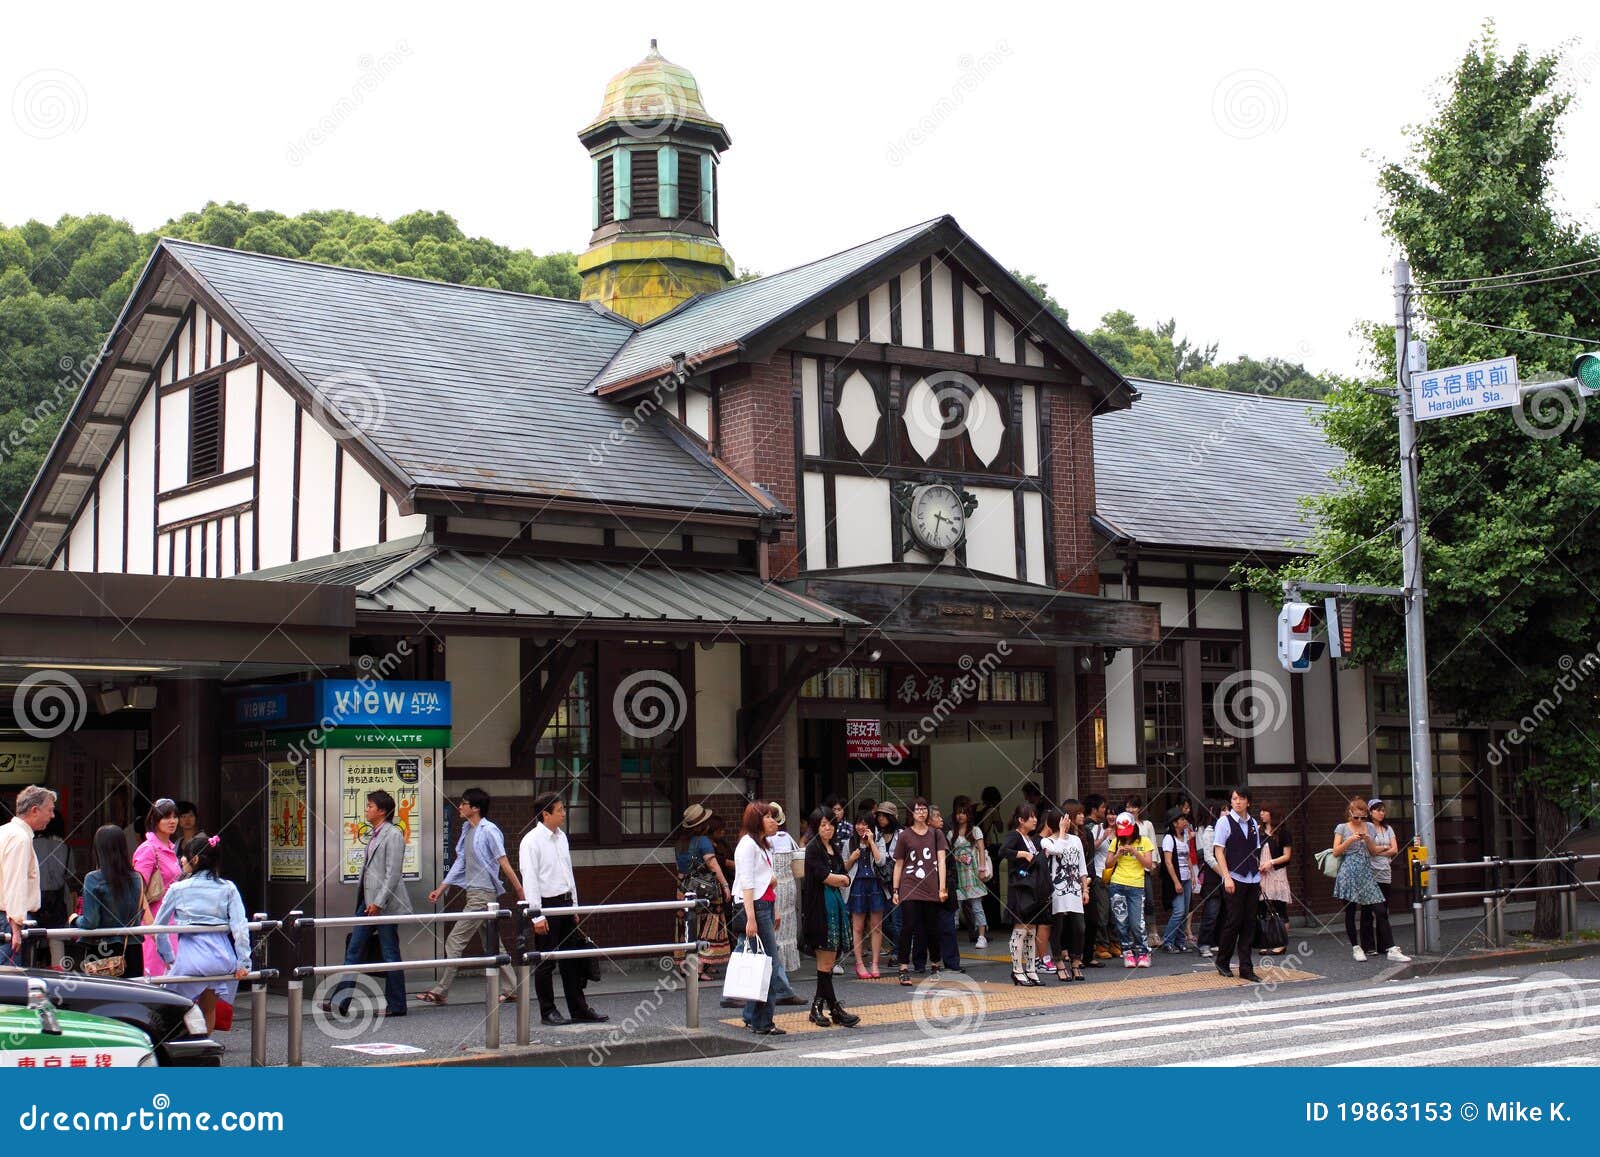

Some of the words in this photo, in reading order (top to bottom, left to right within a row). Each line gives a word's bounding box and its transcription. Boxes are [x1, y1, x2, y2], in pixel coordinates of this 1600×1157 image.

[1421, 366, 1509, 399] 原宿駅前
[1428, 396, 1474, 413] Harajuku
[1482, 391, 1504, 403] Sta.
[335, 691, 406, 714] view
[411, 692, 439, 704] ATM
[411, 704, 441, 714] コーナー
[347, 776, 394, 784] 持ち込まないで
